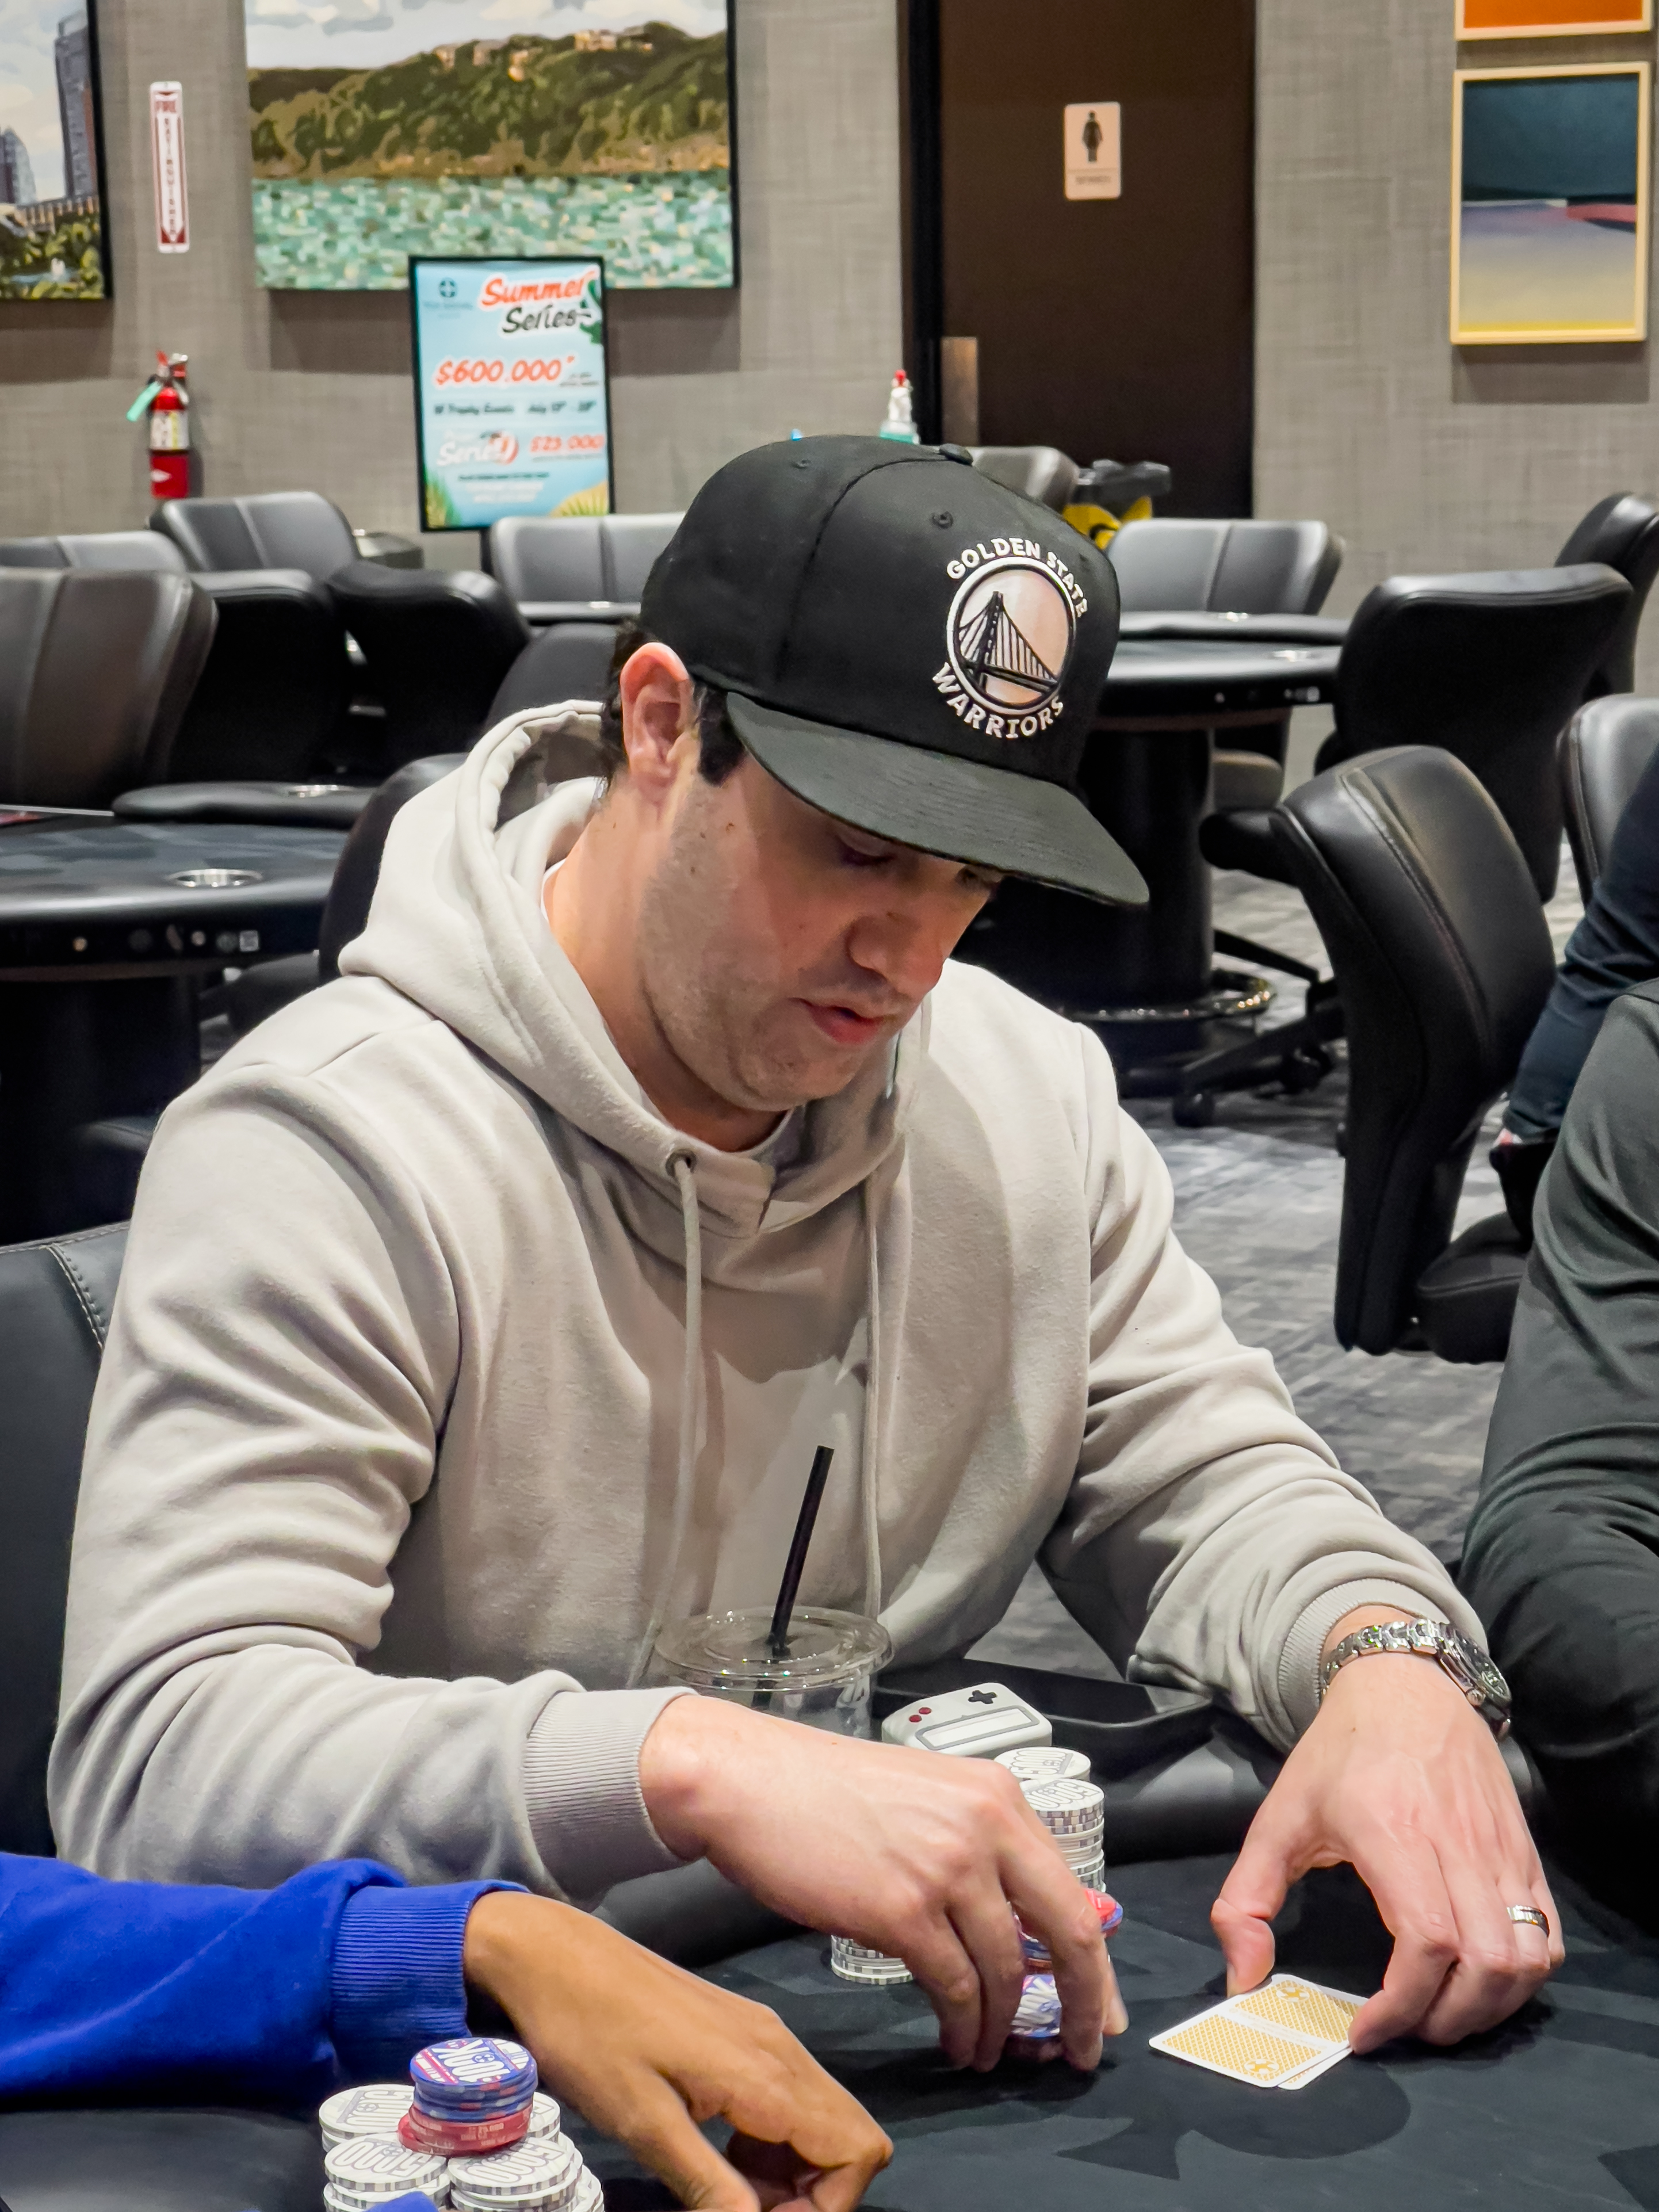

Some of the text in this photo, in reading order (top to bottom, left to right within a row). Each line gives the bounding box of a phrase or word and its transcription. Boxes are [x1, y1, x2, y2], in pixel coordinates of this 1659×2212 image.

[481, 269, 595, 306] Summer
[502, 304, 591, 333] Series
[946, 537, 1088, 618] GOLDEN STATE
[932, 662, 1064, 739] WARRIORS
[1010, 1749, 1066, 1775] 5000
[431, 2039, 511, 2083] 100K
[332, 2141, 431, 2177] 5000
[465, 2141, 564, 2184] 5000
